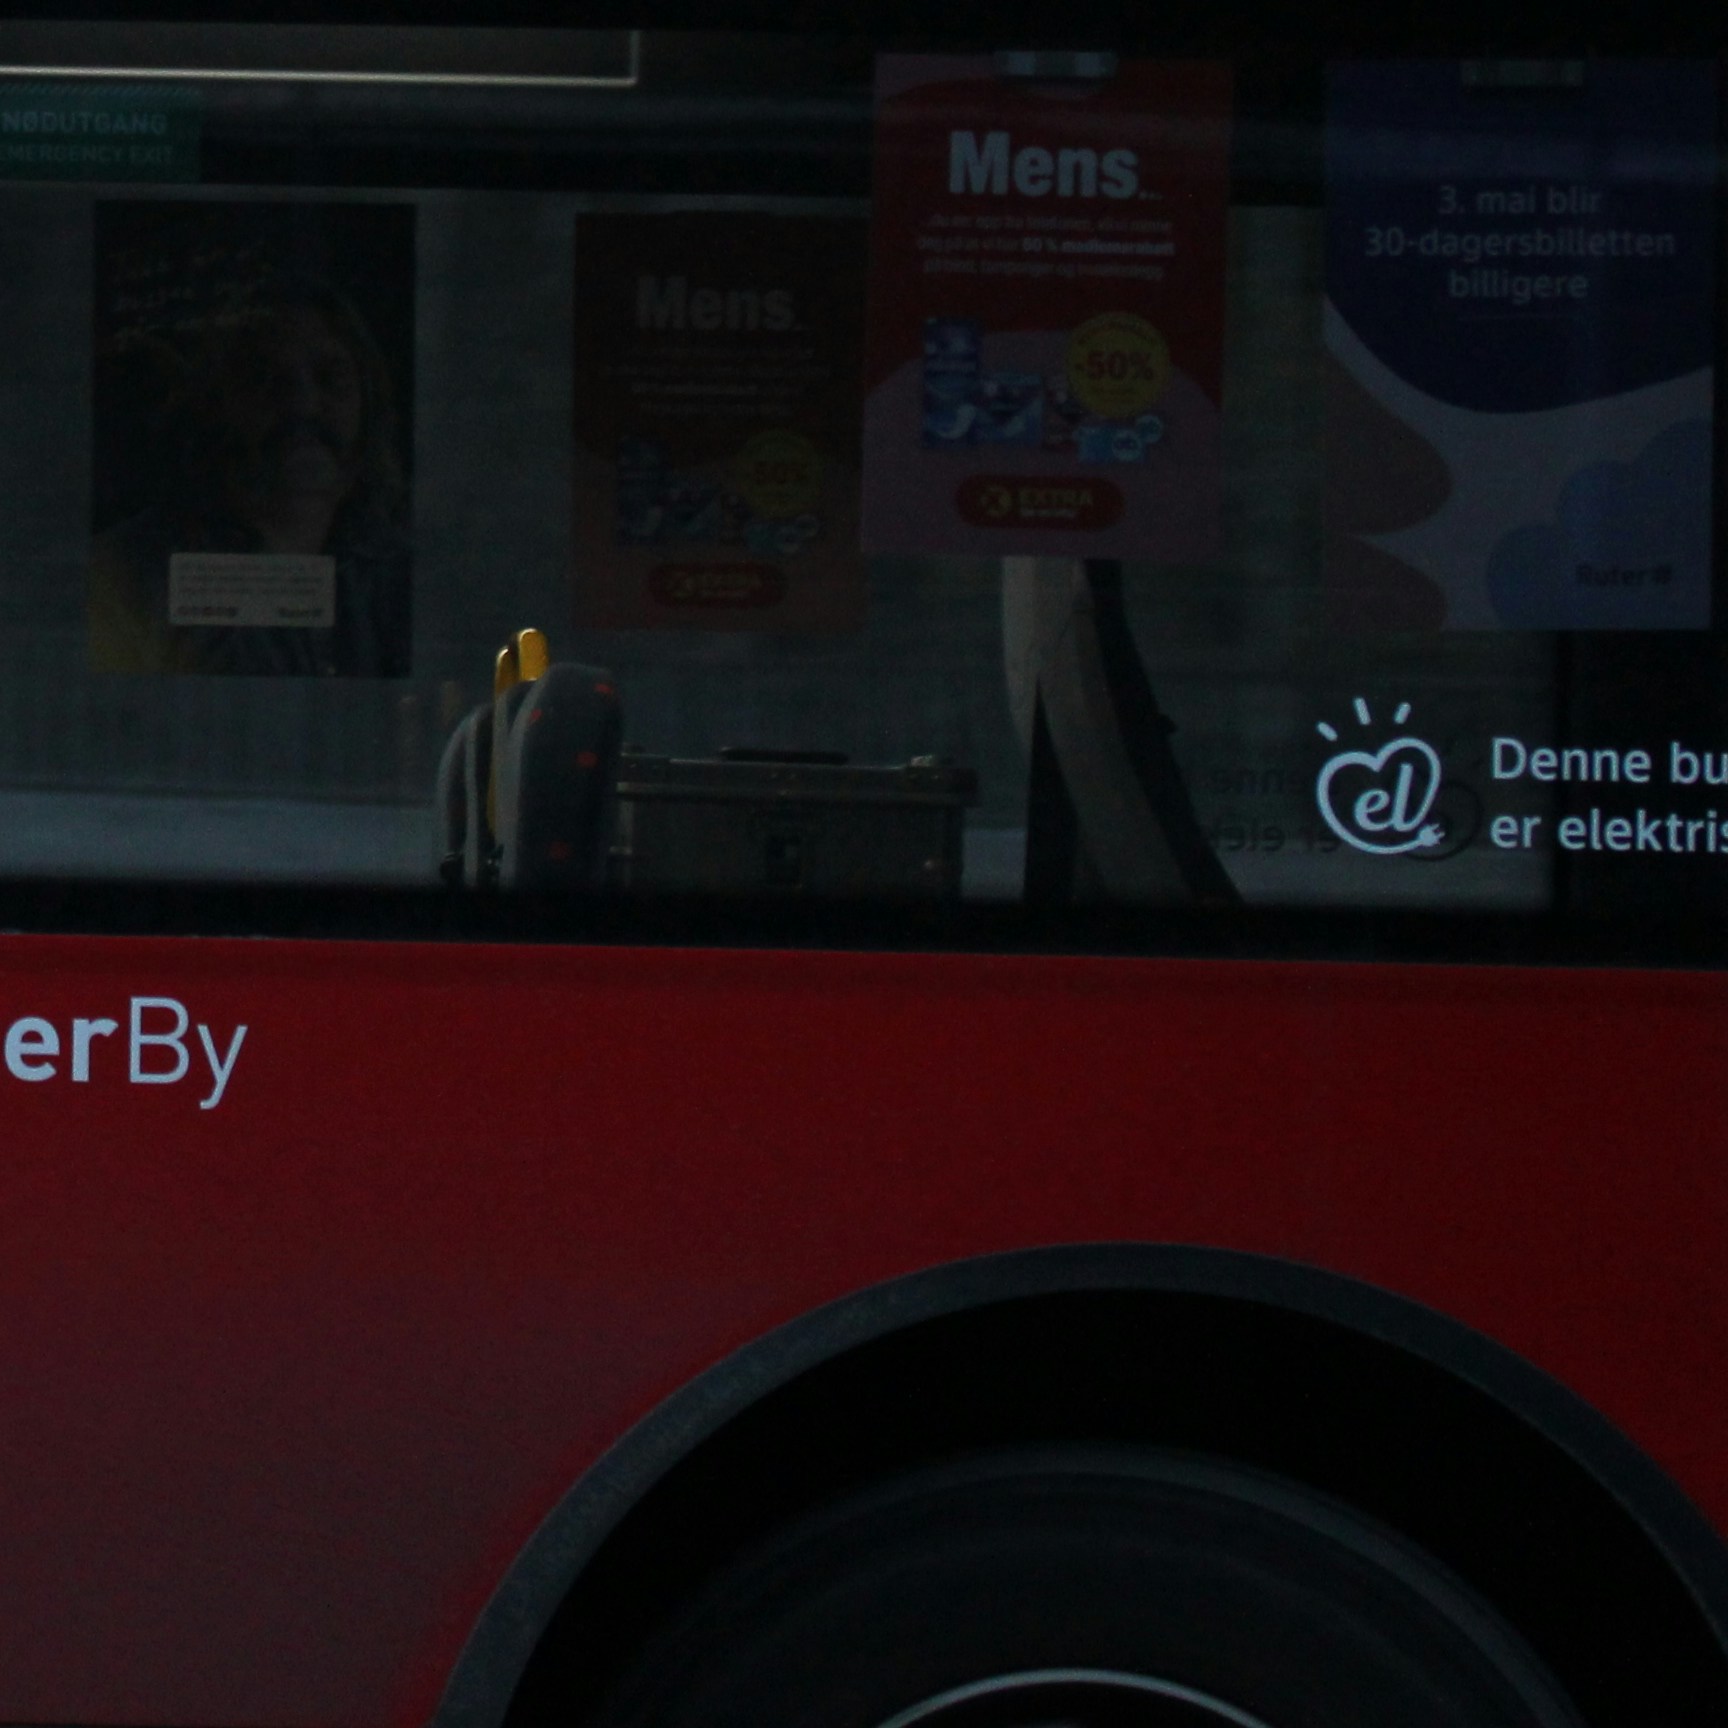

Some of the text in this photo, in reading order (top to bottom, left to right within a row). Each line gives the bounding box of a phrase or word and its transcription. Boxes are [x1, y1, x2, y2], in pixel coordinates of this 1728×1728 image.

[1, 110, 168, 135] NØDUTGANG
[129, 145, 173, 165] EXIT
[1437, 185, 1602, 215] 3. mai blir
[1364, 226, 1676, 265] 30-dagersbilletten
[1449, 269, 1590, 306] billigere
[1490, 736, 1653, 785] Denne
[1489, 813, 1543, 849] er
